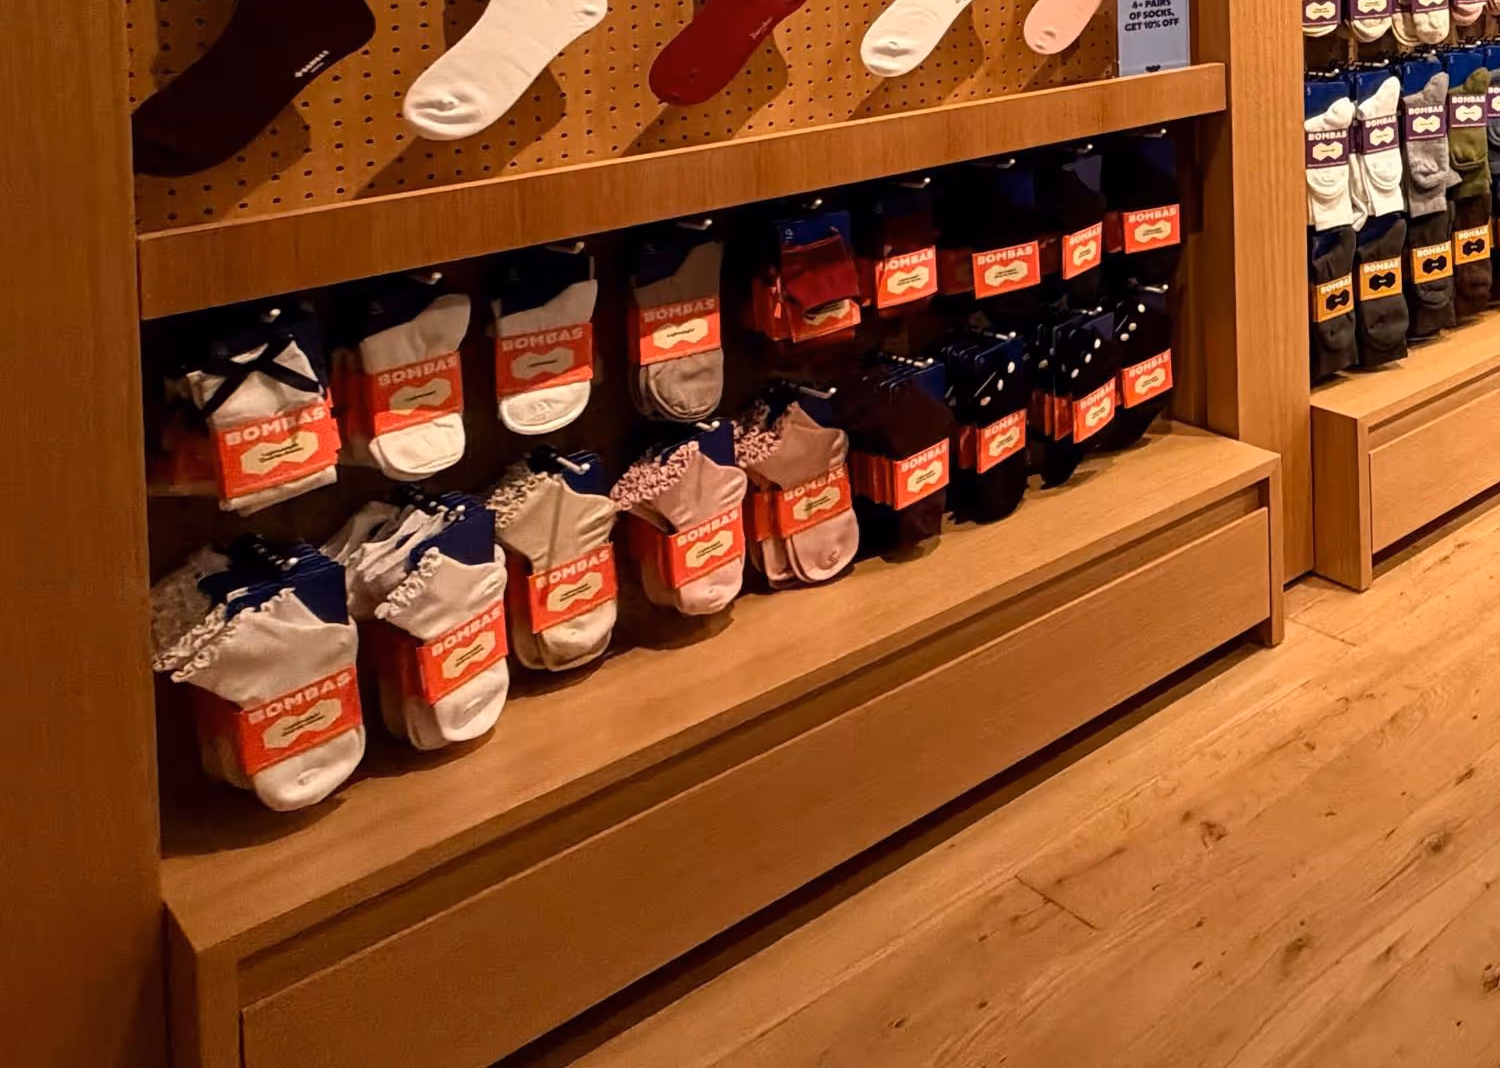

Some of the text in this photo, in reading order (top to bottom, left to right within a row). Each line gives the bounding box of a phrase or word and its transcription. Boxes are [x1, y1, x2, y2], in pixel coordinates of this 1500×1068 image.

[1125, 18, 1179, 31] GET 10% OFF
[1129, 8, 1174, 20] OF SOCKS,
[1409, 105, 1444, 115] BOMBAS
[1452, 96, 1486, 104] BOMBAS
[1366, 116, 1396, 128] BOMBAS
[1308, 132, 1347, 141] BOMBAS
[1128, 207, 1176, 223] BOMBAS
[978, 245, 1033, 265] BOMBAS
[1364, 259, 1400, 272] BOMBAS
[643, 298, 716, 323] BOMBAS
[502, 327, 584, 351] BOMBAS
[377, 354, 457, 386] BOMBAS
[1129, 353, 1170, 377] BOMBAS
[225, 407, 326, 446] BOMBAS
[677, 509, 738, 548] BOMBAS
[536, 550, 609, 589] BOMBAS
[432, 606, 501, 657] BOMBAS
[248, 672, 351, 724] BOMBAS
